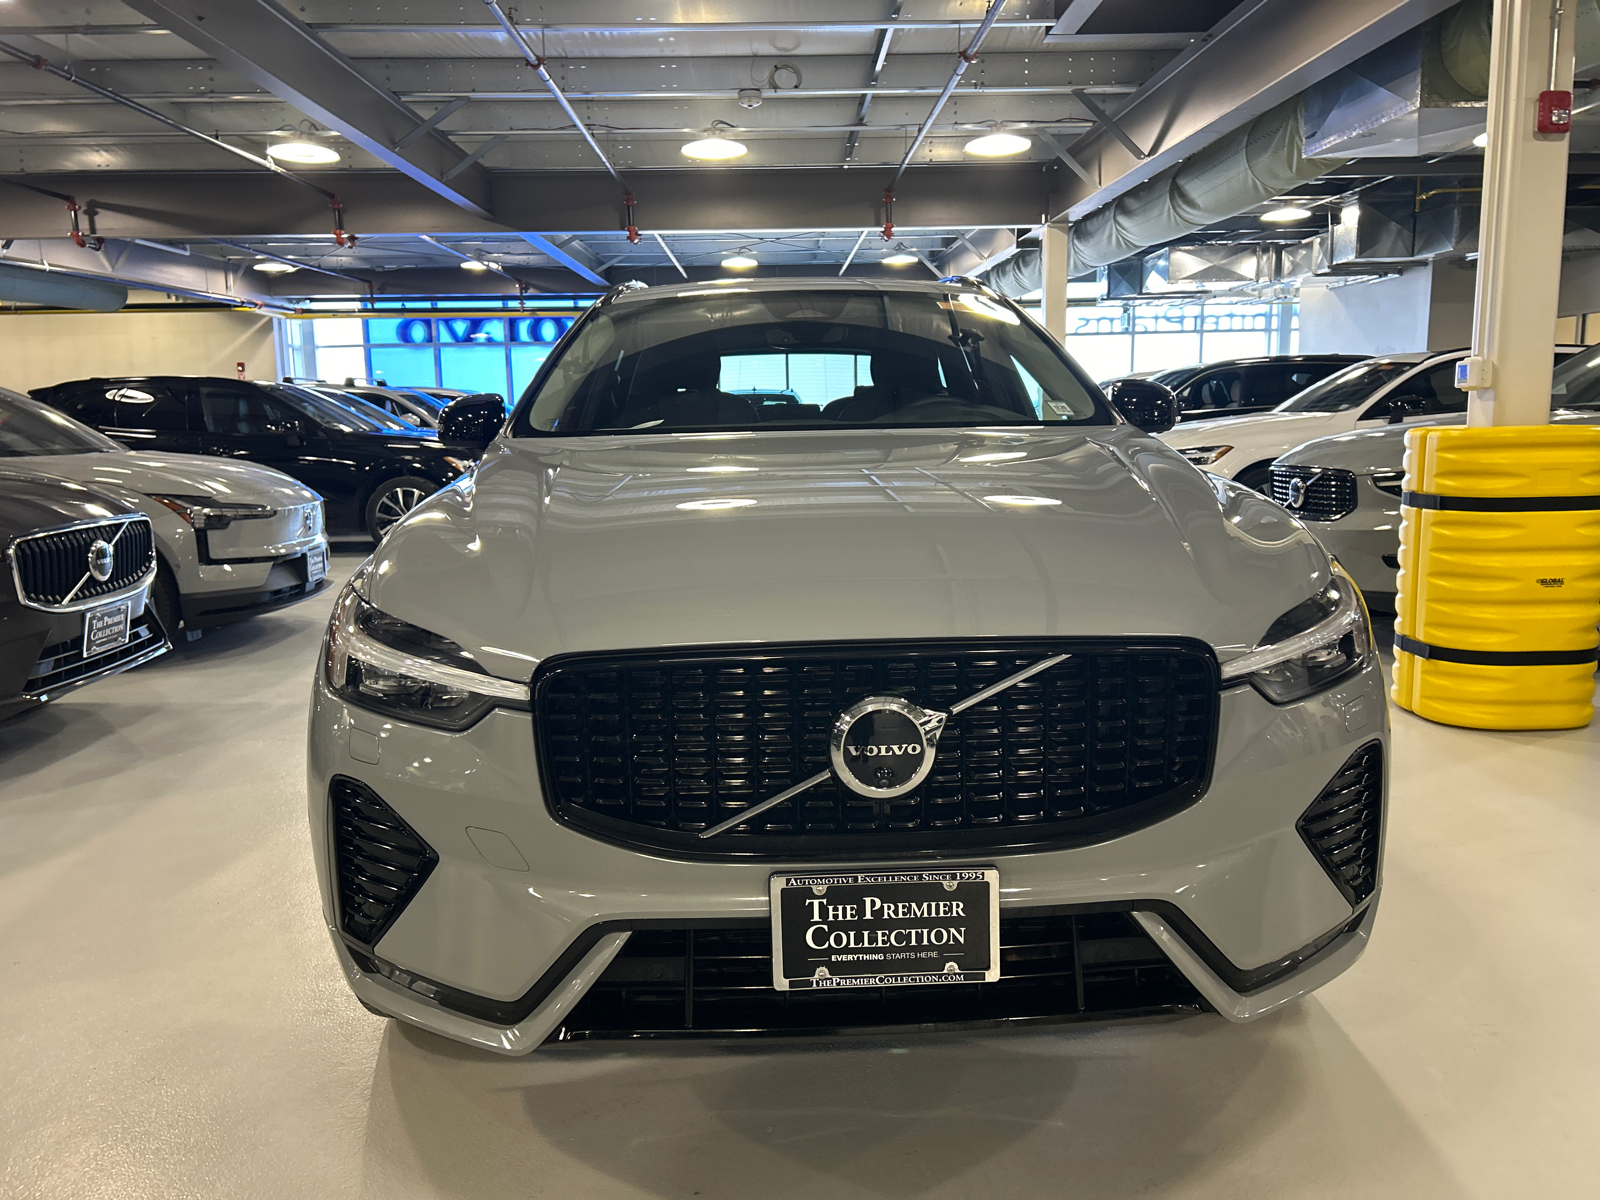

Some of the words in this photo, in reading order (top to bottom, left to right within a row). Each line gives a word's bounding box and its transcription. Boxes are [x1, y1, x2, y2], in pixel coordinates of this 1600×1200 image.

[92, 619, 104, 630] THE
[103, 614, 124, 627] PREMIER
[91, 624, 124, 641] COLLECTION
[847, 743, 922, 757] VOLVO
[788, 876, 854, 887] AUTOMOTIVE
[858, 873, 919, 883] EXCELLENCE
[922, 872, 952, 882] SINCE
[956, 871, 983, 881] 1995
[805, 898, 859, 922] THE
[862, 897, 966, 920] PREMIER
[805, 924, 966, 949] COLLECTION
[831, 953, 884, 962] EVERYTHING
[886, 952, 915, 961] STARTS
[917, 951, 941, 959] HERE.
[810, 973, 965, 988] THEPREMIERCOLLECTION.COM
